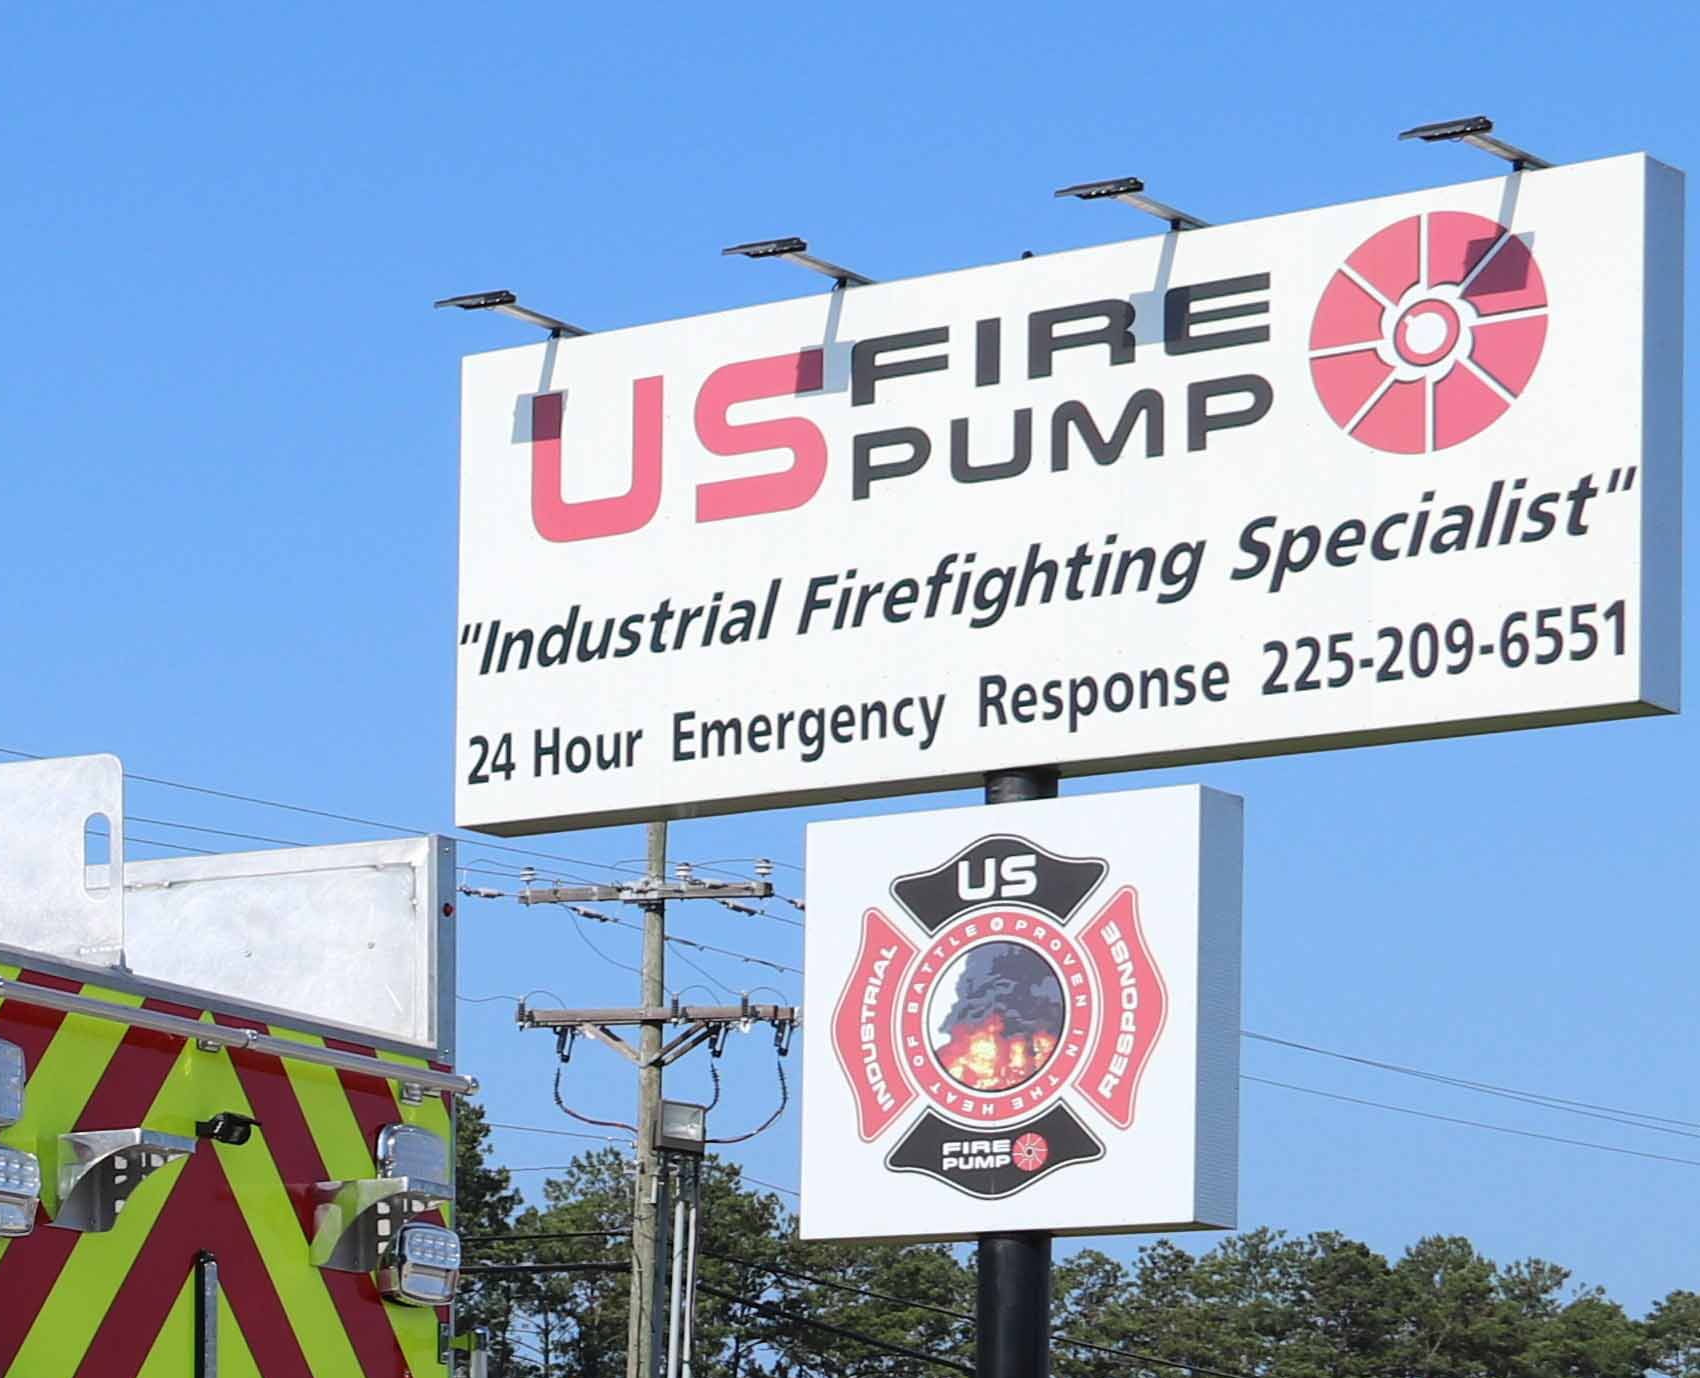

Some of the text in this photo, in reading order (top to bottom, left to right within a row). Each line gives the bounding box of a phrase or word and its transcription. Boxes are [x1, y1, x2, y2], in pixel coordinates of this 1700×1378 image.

[850, 272, 1272, 407] FIRE
[532, 349, 828, 543] US
[851, 374, 1274, 502] PUMP
[797, 533, 1206, 635] Firefighting
[467, 599, 1626, 785] 24 Hour Emergency Response 225-209-6551
[957, 854, 1038, 900] US
[860, 943, 899, 1112] INDUSTRIAL
[908, 919, 1087, 1116] PROVEN IN THE HEAT OF BATTLE
[1098, 920, 1139, 1099] RESPONSE
[942, 1139, 1011, 1156] FIRE
[942, 1154, 1011, 1170] PUMP
